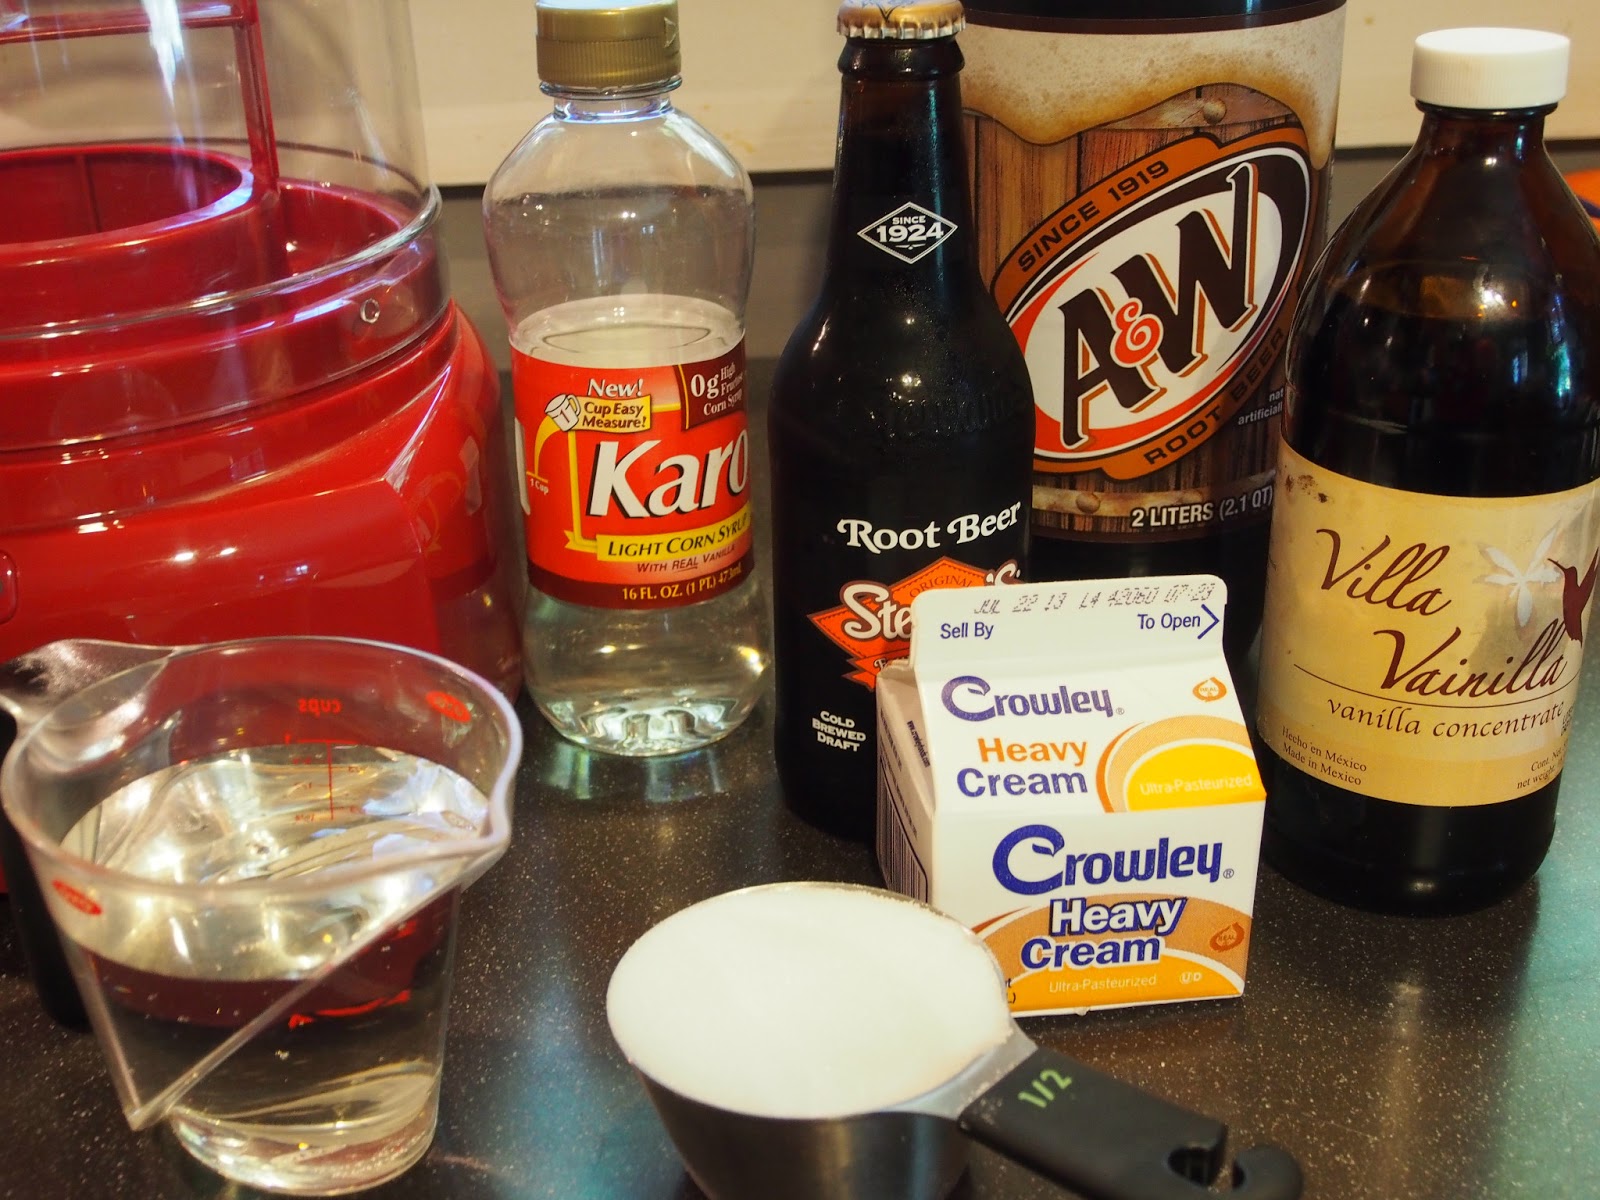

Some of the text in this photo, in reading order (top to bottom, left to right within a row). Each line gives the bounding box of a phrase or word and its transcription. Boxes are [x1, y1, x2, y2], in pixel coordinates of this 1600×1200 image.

[892, 215, 926, 225] SINCE
[1018, 160, 1169, 272] SINCE 1919
[876, 221, 944, 243] 1924
[1059, 161, 1258, 452] A&W
[587, 378, 644, 397] New!
[690, 362, 736, 399] 0g High
[703, 400, 727, 416] Corn
[1143, 326, 1288, 465] ROOT BEER
[582, 416, 647, 430] Measure!
[583, 401, 611, 420] Cup
[613, 404, 644, 421] Easy
[1238, 401, 1283, 426] artificiall
[586, 429, 748, 518] Karo
[535, 480, 549, 496] Cup
[1131, 485, 1273, 527] 2 LITERS (2.1 QT)
[836, 501, 1021, 554] Root Beer
[607, 540, 663, 557] LIGHT
[666, 532, 716, 555] CORN
[637, 562, 668, 574] WITH
[672, 556, 699, 571] REAL
[1316, 527, 1452, 616] Villa
[622, 587, 637, 600] 16
[640, 586, 657, 600] FL.
[660, 584, 683, 598] OZ.
[974, 598, 1000, 615] JUL
[1012, 594, 1039, 613] 22
[940, 622, 994, 641] Sell By
[1137, 612, 1201, 632] To Open
[1373, 618, 1568, 698] Vainilla
[941, 675, 1114, 721] Crowley
[812, 717, 866, 742] BREWED
[820, 710, 855, 728] COLD
[1327, 698, 1420, 735] vanilla
[1432, 700, 1565, 738] concentrate
[817, 731, 860, 752] DRAFT
[977, 736, 1087, 766] Heavy
[1282, 725, 1367, 772] Hecho en México
[1283, 742, 1362, 785] Made in Mexico
[956, 766, 1088, 798] Cream
[1139, 773, 1253, 796] Ultra-Pasteurized
[991, 823, 1223, 896] Crowley
[1049, 897, 1188, 937] Heavy
[1020, 936, 1162, 970] Cream
[1048, 973, 1157, 994] Ultra-Pasteurized
[1018, 1068, 1073, 1109] 1/2
